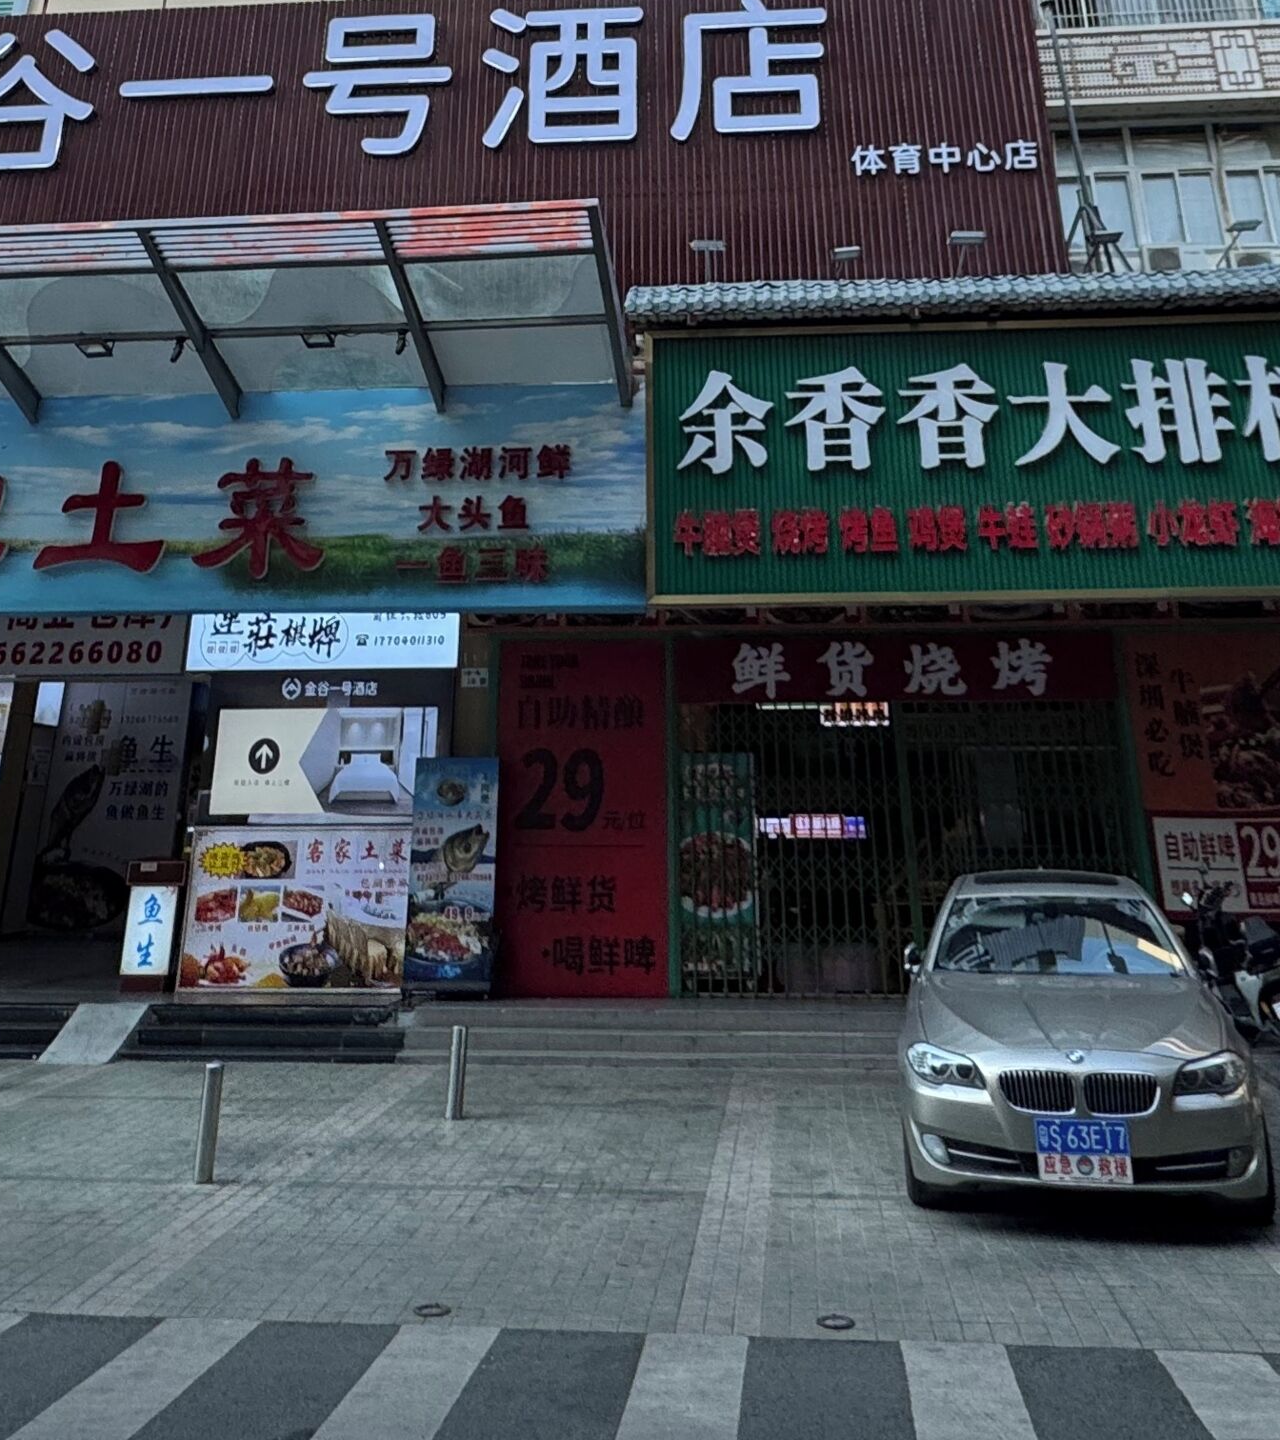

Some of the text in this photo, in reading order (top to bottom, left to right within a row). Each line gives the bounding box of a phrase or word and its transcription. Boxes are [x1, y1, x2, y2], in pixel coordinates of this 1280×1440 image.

[851, 140, 1039, 176] 体育中心店
[383, 444, 572, 482] 万绿湖河鲜
[417, 495, 529, 532] 大头鱼
[395, 544, 549, 584] 一鱼三味
[731, 639, 1052, 698] 鲜货烧烤
[304, 681, 379, 698] 金谷一号酒店
[518, 695, 644, 730] 自助精酿
[1135, 652, 1175, 777] 深圳必吃
[121, 734, 173, 764] 鱼生
[110, 780, 169, 797] 万绿湖的
[514, 748, 604, 831] 29
[306, 838, 409, 864] 客家土菜
[517, 875, 616, 913] 烤鲜货
[135, 894, 163, 967] 鱼生
